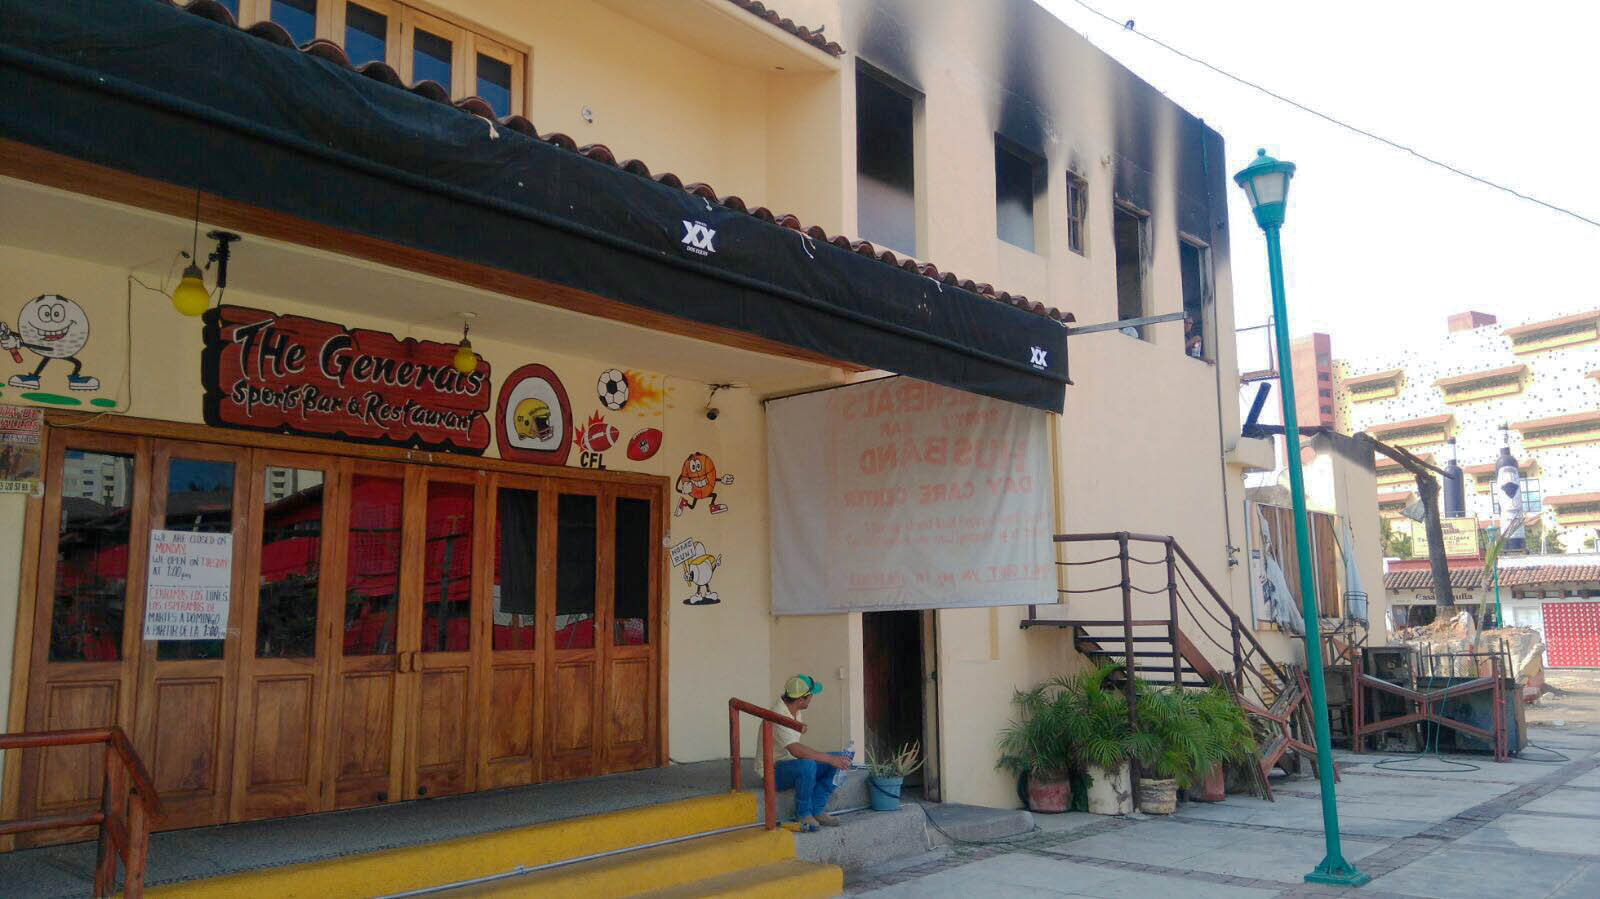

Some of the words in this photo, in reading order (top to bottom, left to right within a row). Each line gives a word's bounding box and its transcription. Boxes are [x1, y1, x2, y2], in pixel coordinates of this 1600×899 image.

[681, 220, 716, 252] XX
[231, 379, 302, 417] Sports
[301, 383, 344, 420] Bar
[346, 396, 364, 420] &
[363, 391, 482, 441] Restaurant
[580, 451, 606, 471] CFL
[189, 536, 215, 544] CLOSED
[167, 556, 186, 566] OPEN
